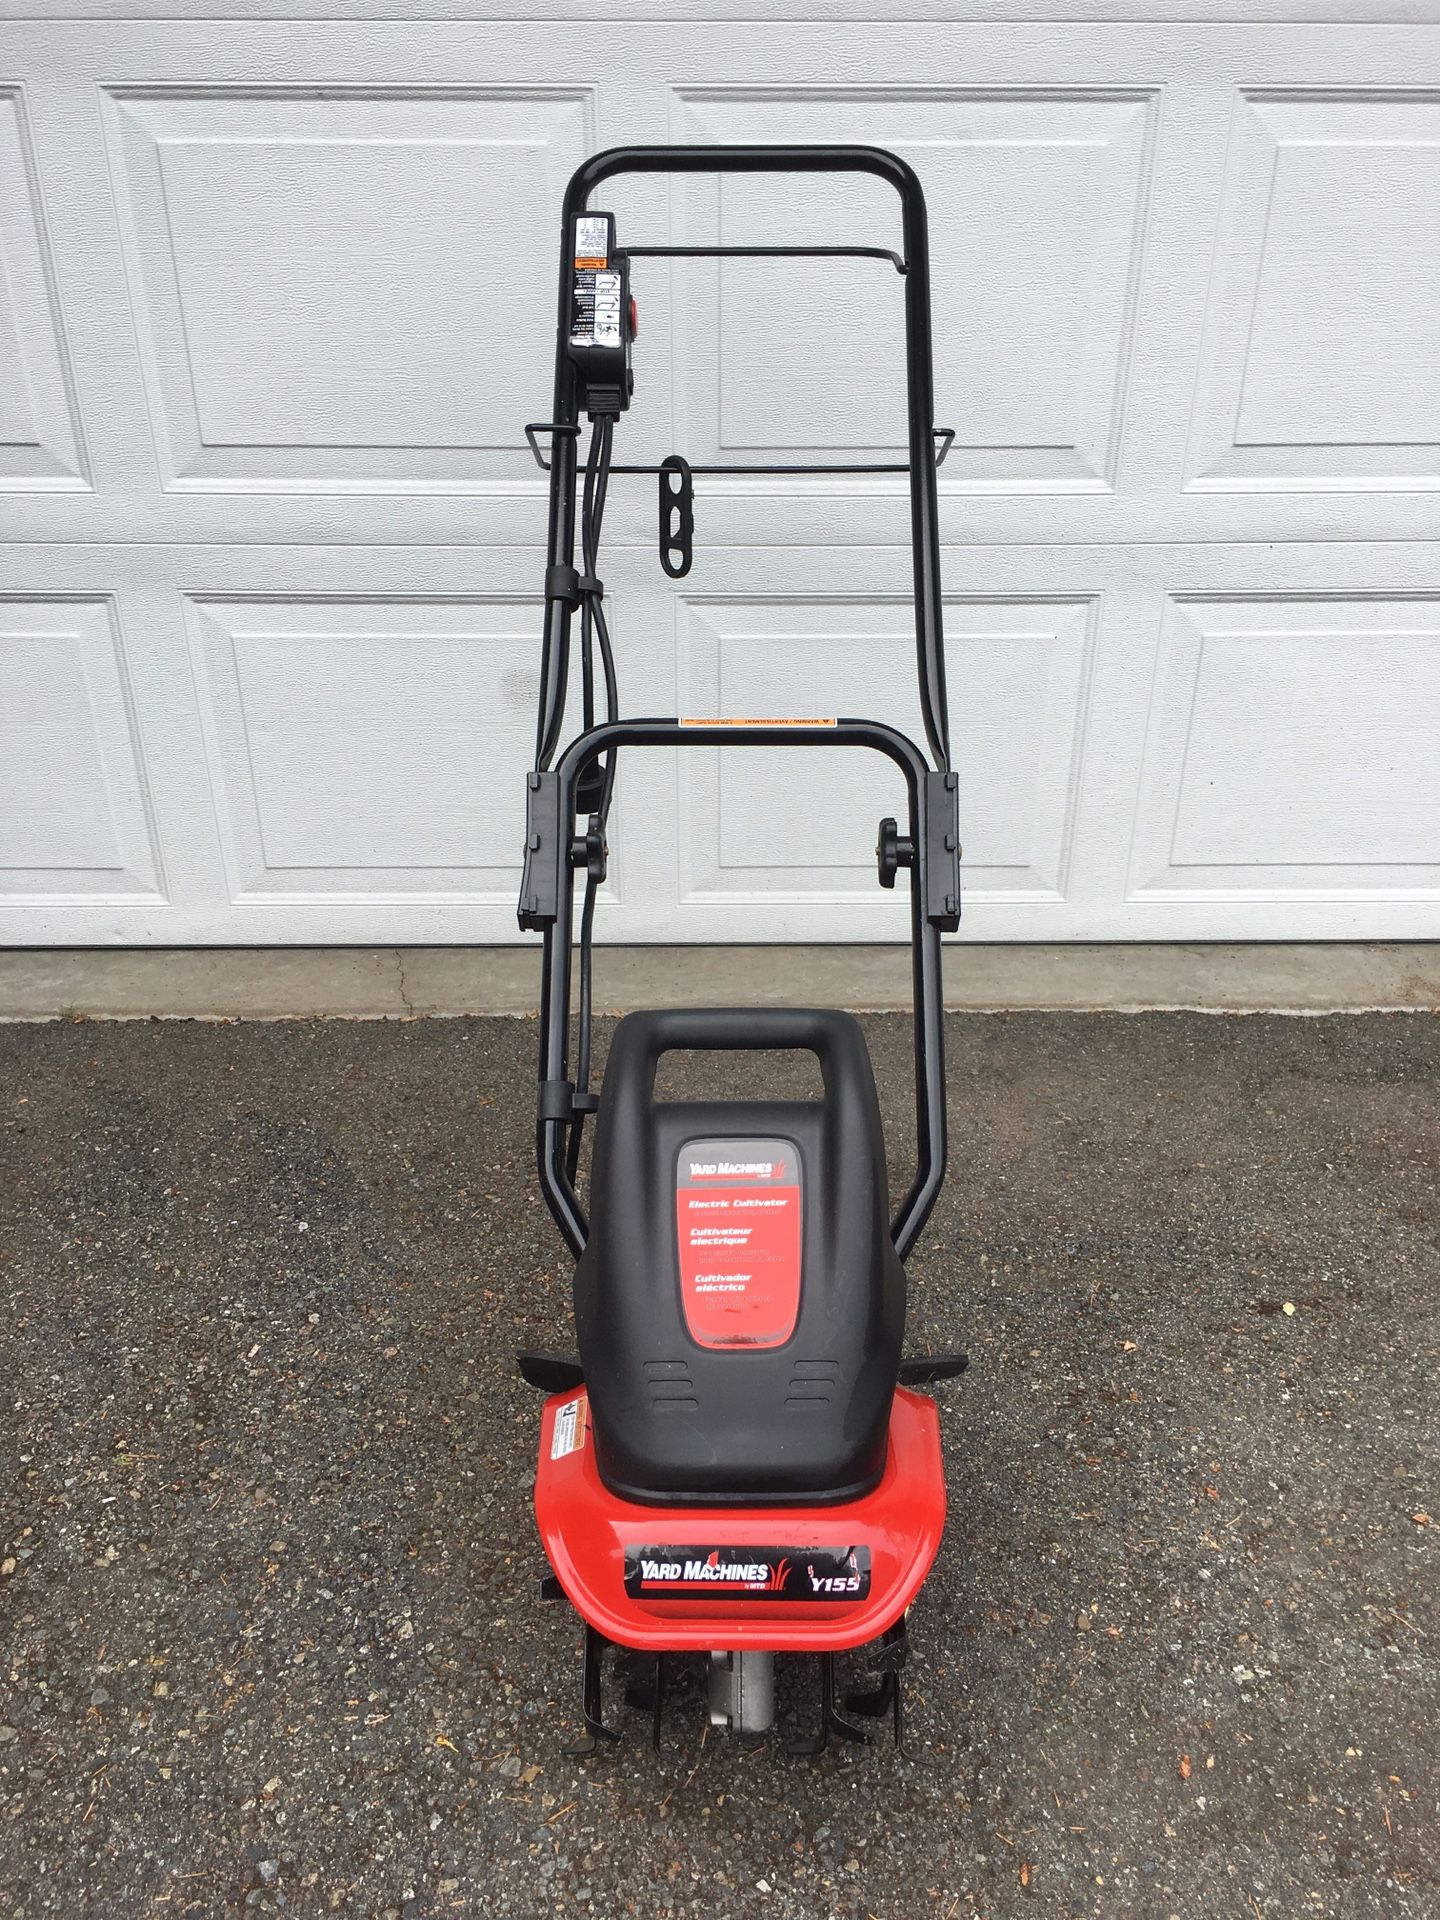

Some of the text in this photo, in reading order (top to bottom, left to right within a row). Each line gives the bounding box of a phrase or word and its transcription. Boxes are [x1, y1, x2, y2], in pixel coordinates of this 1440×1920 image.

[690, 1163, 772, 1175] YARD MACHINES
[688, 1199, 788, 1208] Electric Cultivator
[690, 1227, 753, 1236] Cultivateur
[695, 1274, 753, 1283] Cultivador
[641, 1560, 768, 1580] YARD MACHINES
[811, 1577, 860, 1592] Y155
